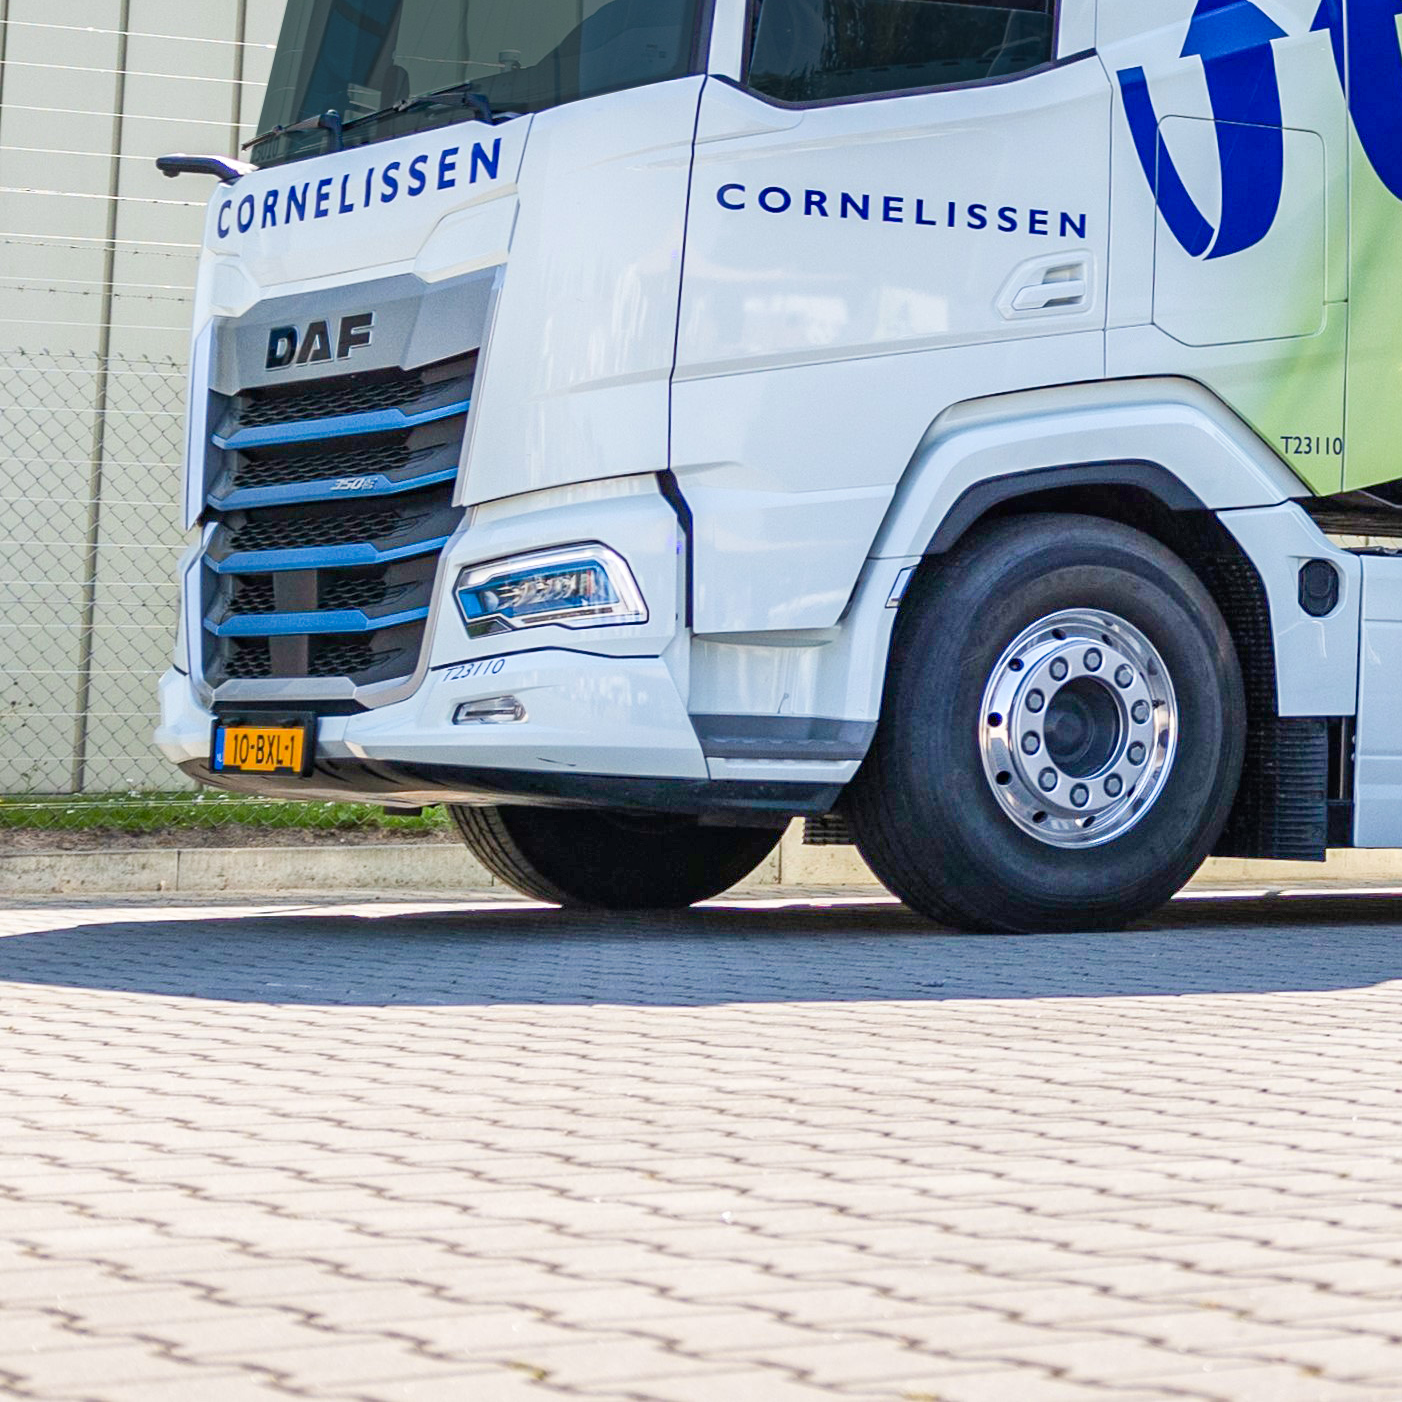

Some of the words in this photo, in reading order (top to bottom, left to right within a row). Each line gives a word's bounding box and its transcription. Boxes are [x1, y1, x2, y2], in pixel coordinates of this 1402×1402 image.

[217, 137, 502, 238] CORNELISSEN
[716, 183, 1086, 239] CORNELISSEN
[264, 310, 375, 371] DAF
[1281, 435, 1342, 456] T23110
[443, 658, 506, 682] T23110
[233, 733, 295, 766] 10-BXL-1
